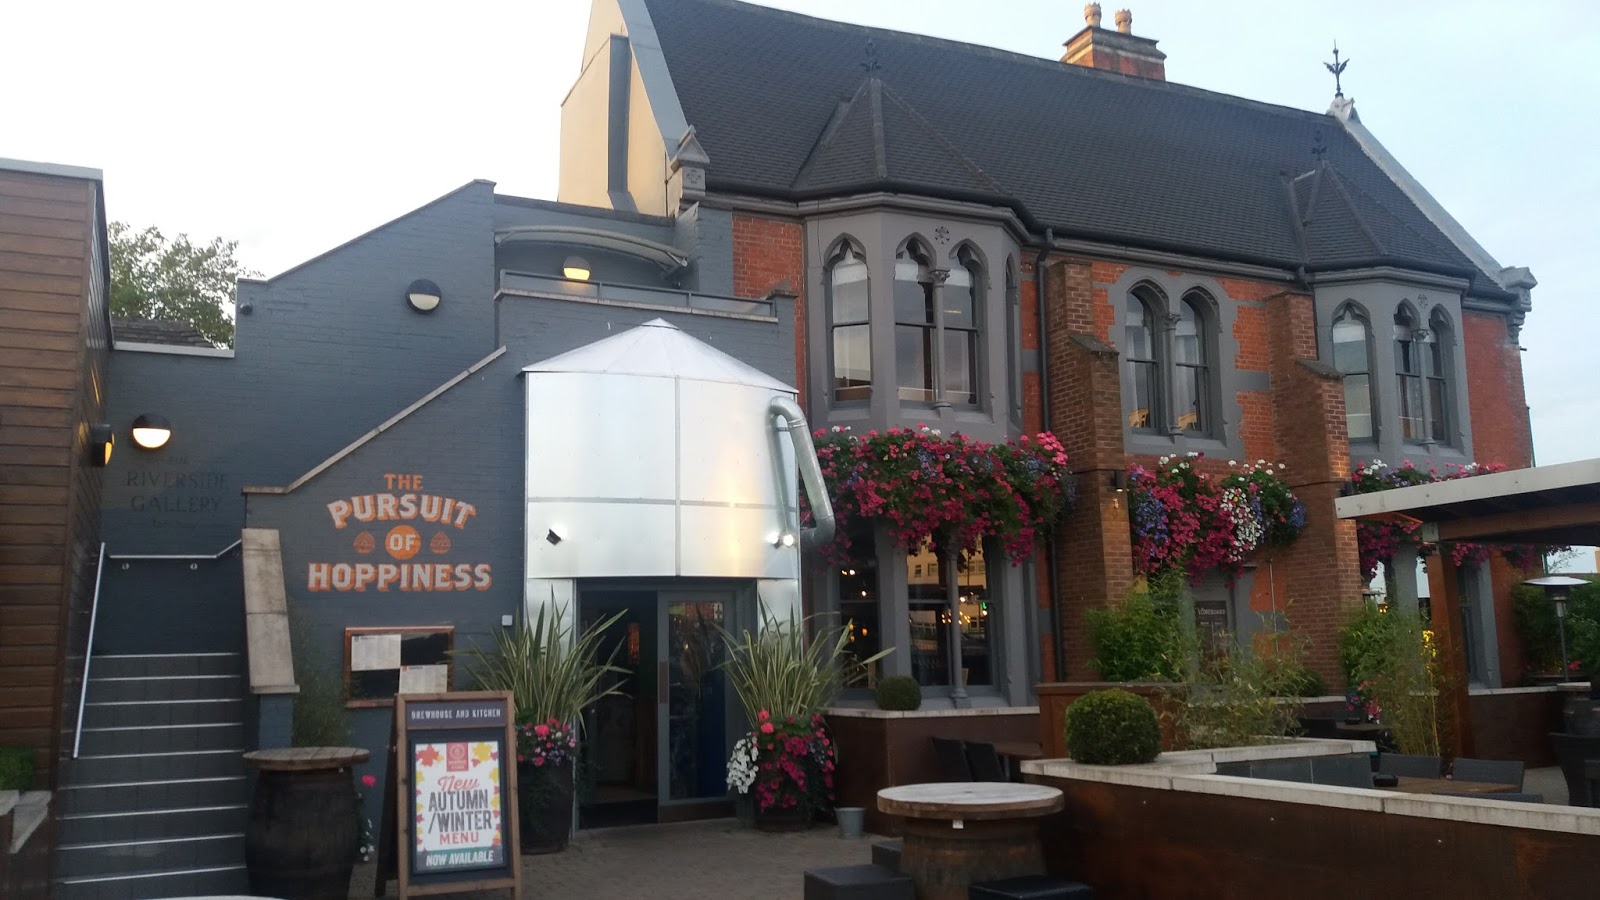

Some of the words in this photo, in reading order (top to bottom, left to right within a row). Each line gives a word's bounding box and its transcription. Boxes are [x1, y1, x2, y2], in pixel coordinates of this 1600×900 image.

[126, 471, 231, 489] RIVERSIDE
[384, 473, 423, 490] THE
[130, 495, 222, 513] GALLERY
[327, 493, 477, 529] PURSUIT
[390, 533, 416, 551] OF
[308, 563, 493, 592] HOPPINESS
[411, 710, 453, 720] BREWHOUSE
[455, 710, 470, 719] AND
[472, 708, 501, 718] KITCHEN
[437, 775, 480, 795] New
[428, 789, 489, 812] AUTUMN
[428, 809, 492, 834] /WINTER
[439, 832, 479, 845] MENU
[426, 854, 447, 867] NOW
[448, 850, 494, 865] AVAILABLE
